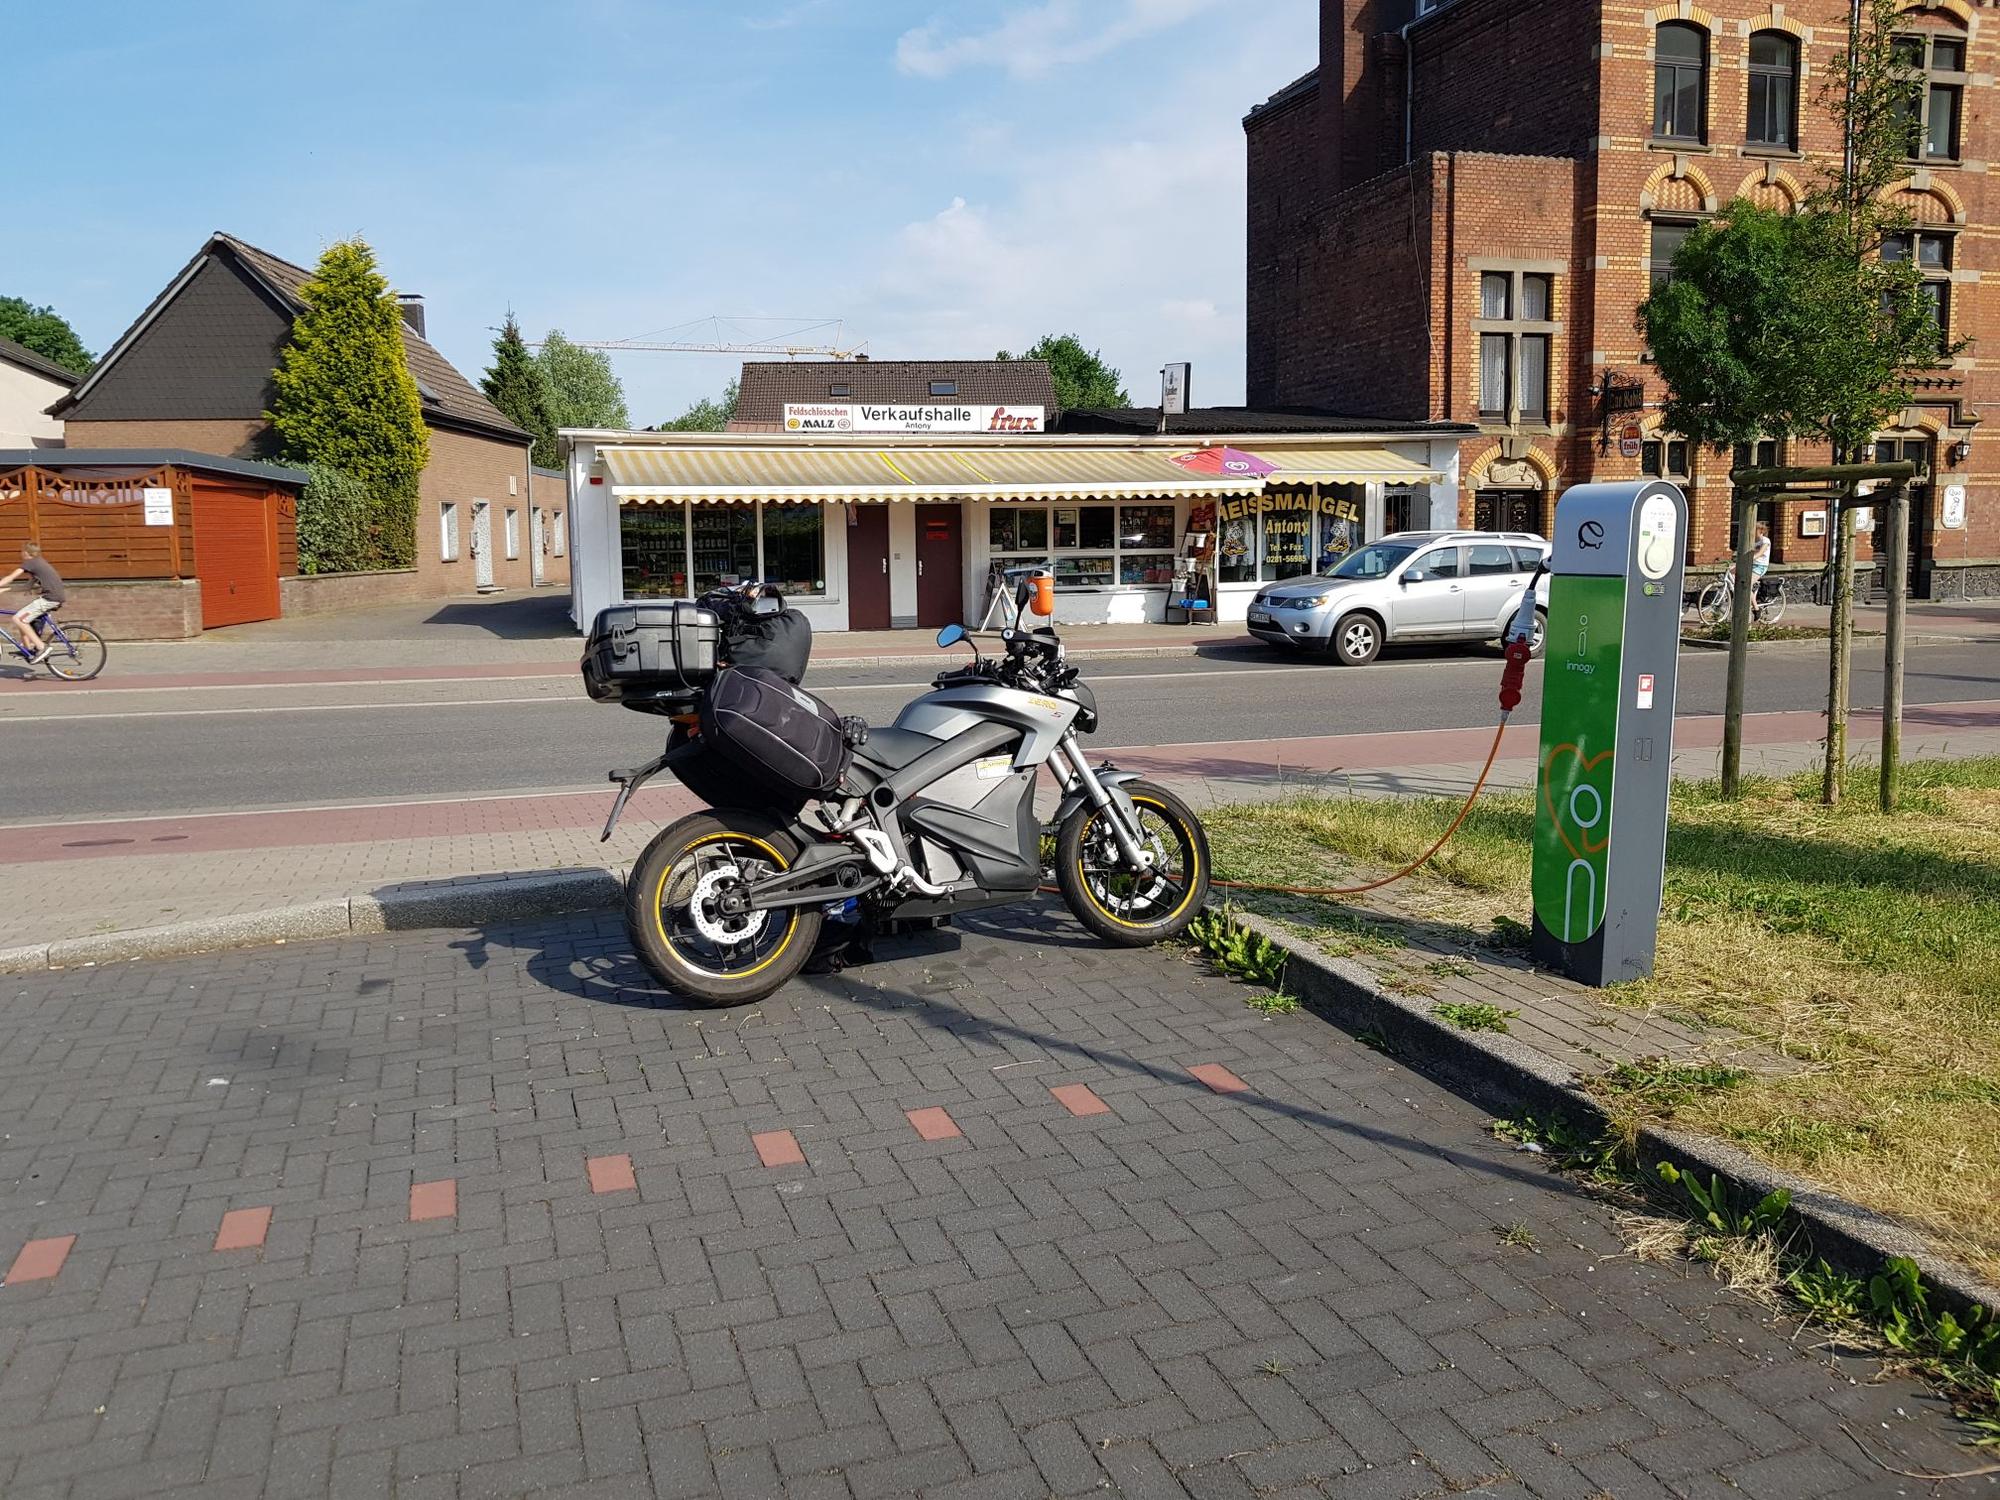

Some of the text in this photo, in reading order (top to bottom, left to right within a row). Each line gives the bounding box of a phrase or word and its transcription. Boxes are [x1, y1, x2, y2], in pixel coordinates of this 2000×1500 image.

[788, 406, 848, 416] Feldschlösschen
[861, 406, 971, 421] Verkaufshalle
[802, 419, 835, 429] MALZ
[905, 422, 932, 430] Antony
[1265, 519, 1309, 536] Antony
[1566, 659, 1595, 674] innogy
